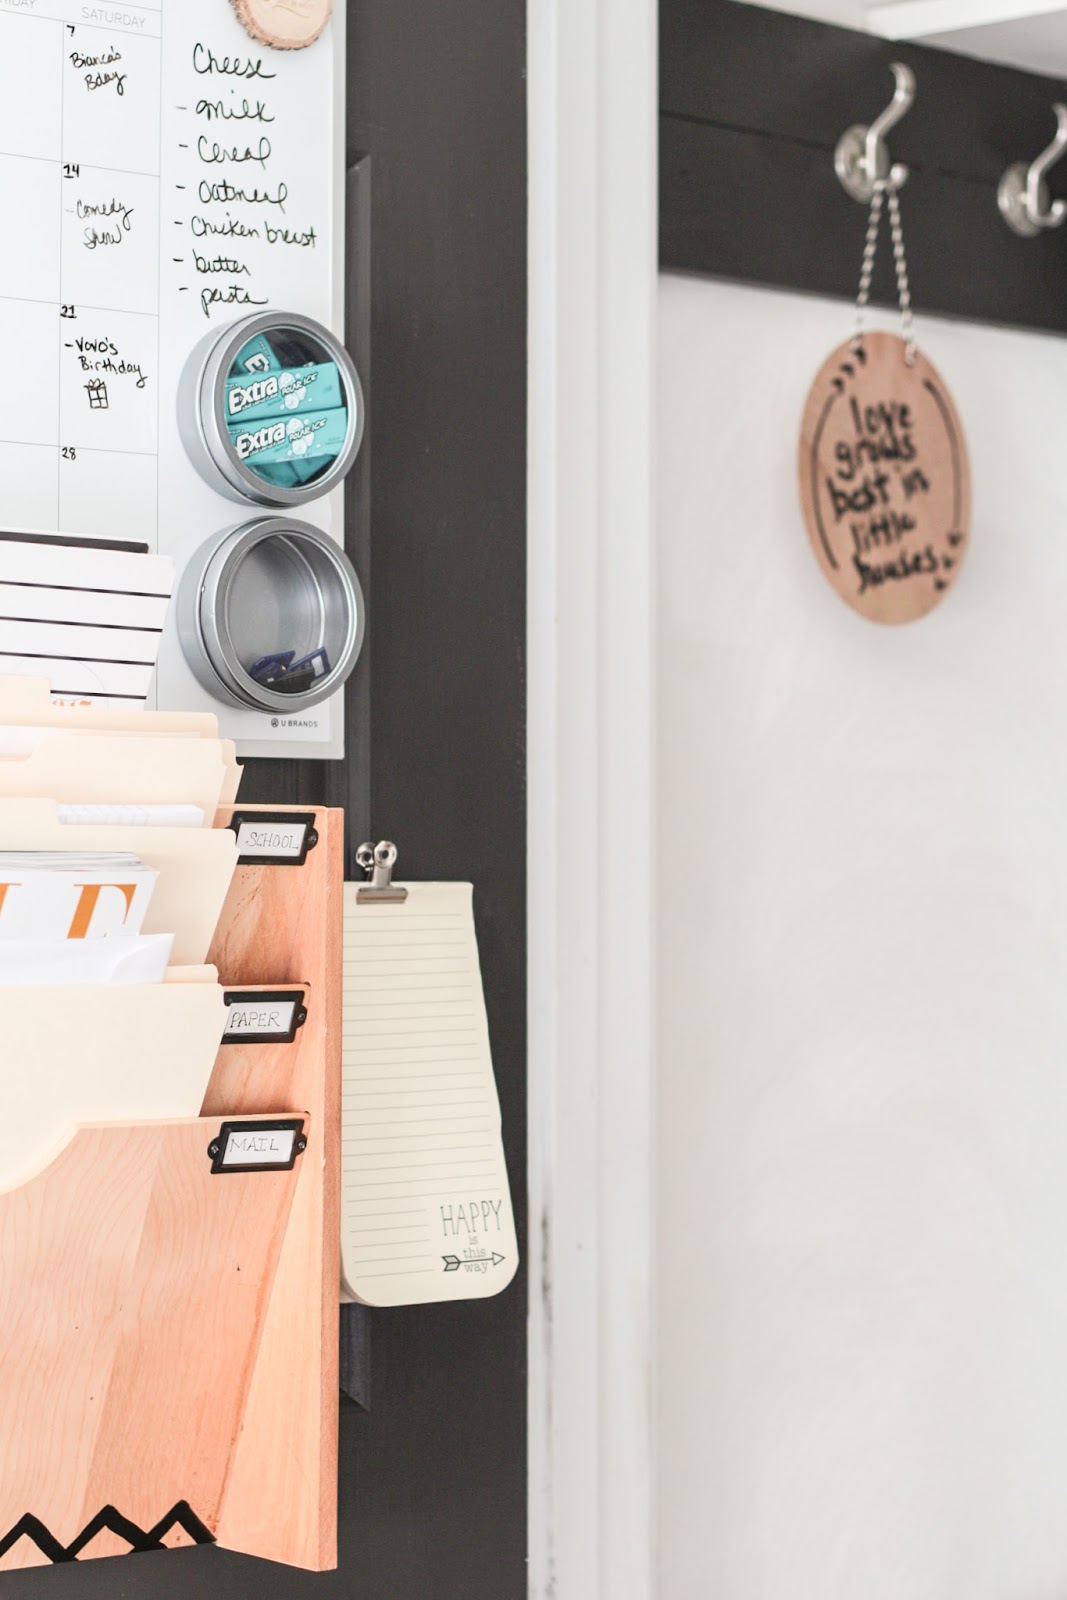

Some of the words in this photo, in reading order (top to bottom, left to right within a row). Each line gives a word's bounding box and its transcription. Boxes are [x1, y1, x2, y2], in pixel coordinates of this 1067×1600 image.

[81, 6, 147, 28] SATURDAY
[66, 24, 75, 37] 7
[192, 42, 277, 79] Cheese
[84, 71, 128, 96] Bday
[197, 134, 271, 170] Cereal
[63, 163, 80, 179] 14
[77, 197, 134, 231] Comedy
[192, 248, 251, 276] butter
[60, 305, 77, 319] 21
[201, 284, 269, 318] pasta
[78, 355, 148, 388] Birthday
[228, 376, 278, 415] Extra
[281, 381, 303, 396] POLAR
[303, 372, 319, 385] ICE
[850, 396, 912, 436] love
[236, 422, 286, 460] Extra
[289, 427, 311, 443] POLAR
[311, 417, 328, 431] ICE
[61, 446, 77, 460] 28
[835, 434, 916, 480] grows
[826, 470, 890, 524] best
[901, 463, 930, 499] in
[850, 510, 916, 551] little
[280, 719, 287, 728] U
[287, 720, 318, 728] BRANDS
[247, 831, 299, 849] SCHOOL
[229, 1010, 280, 1028] PAPER
[229, 1137, 279, 1152] MAIL
[440, 1199, 502, 1236] HAPPY
[463, 1247, 487, 1259] this
[468, 1234, 479, 1246] is
[463, 1262, 488, 1274] way
